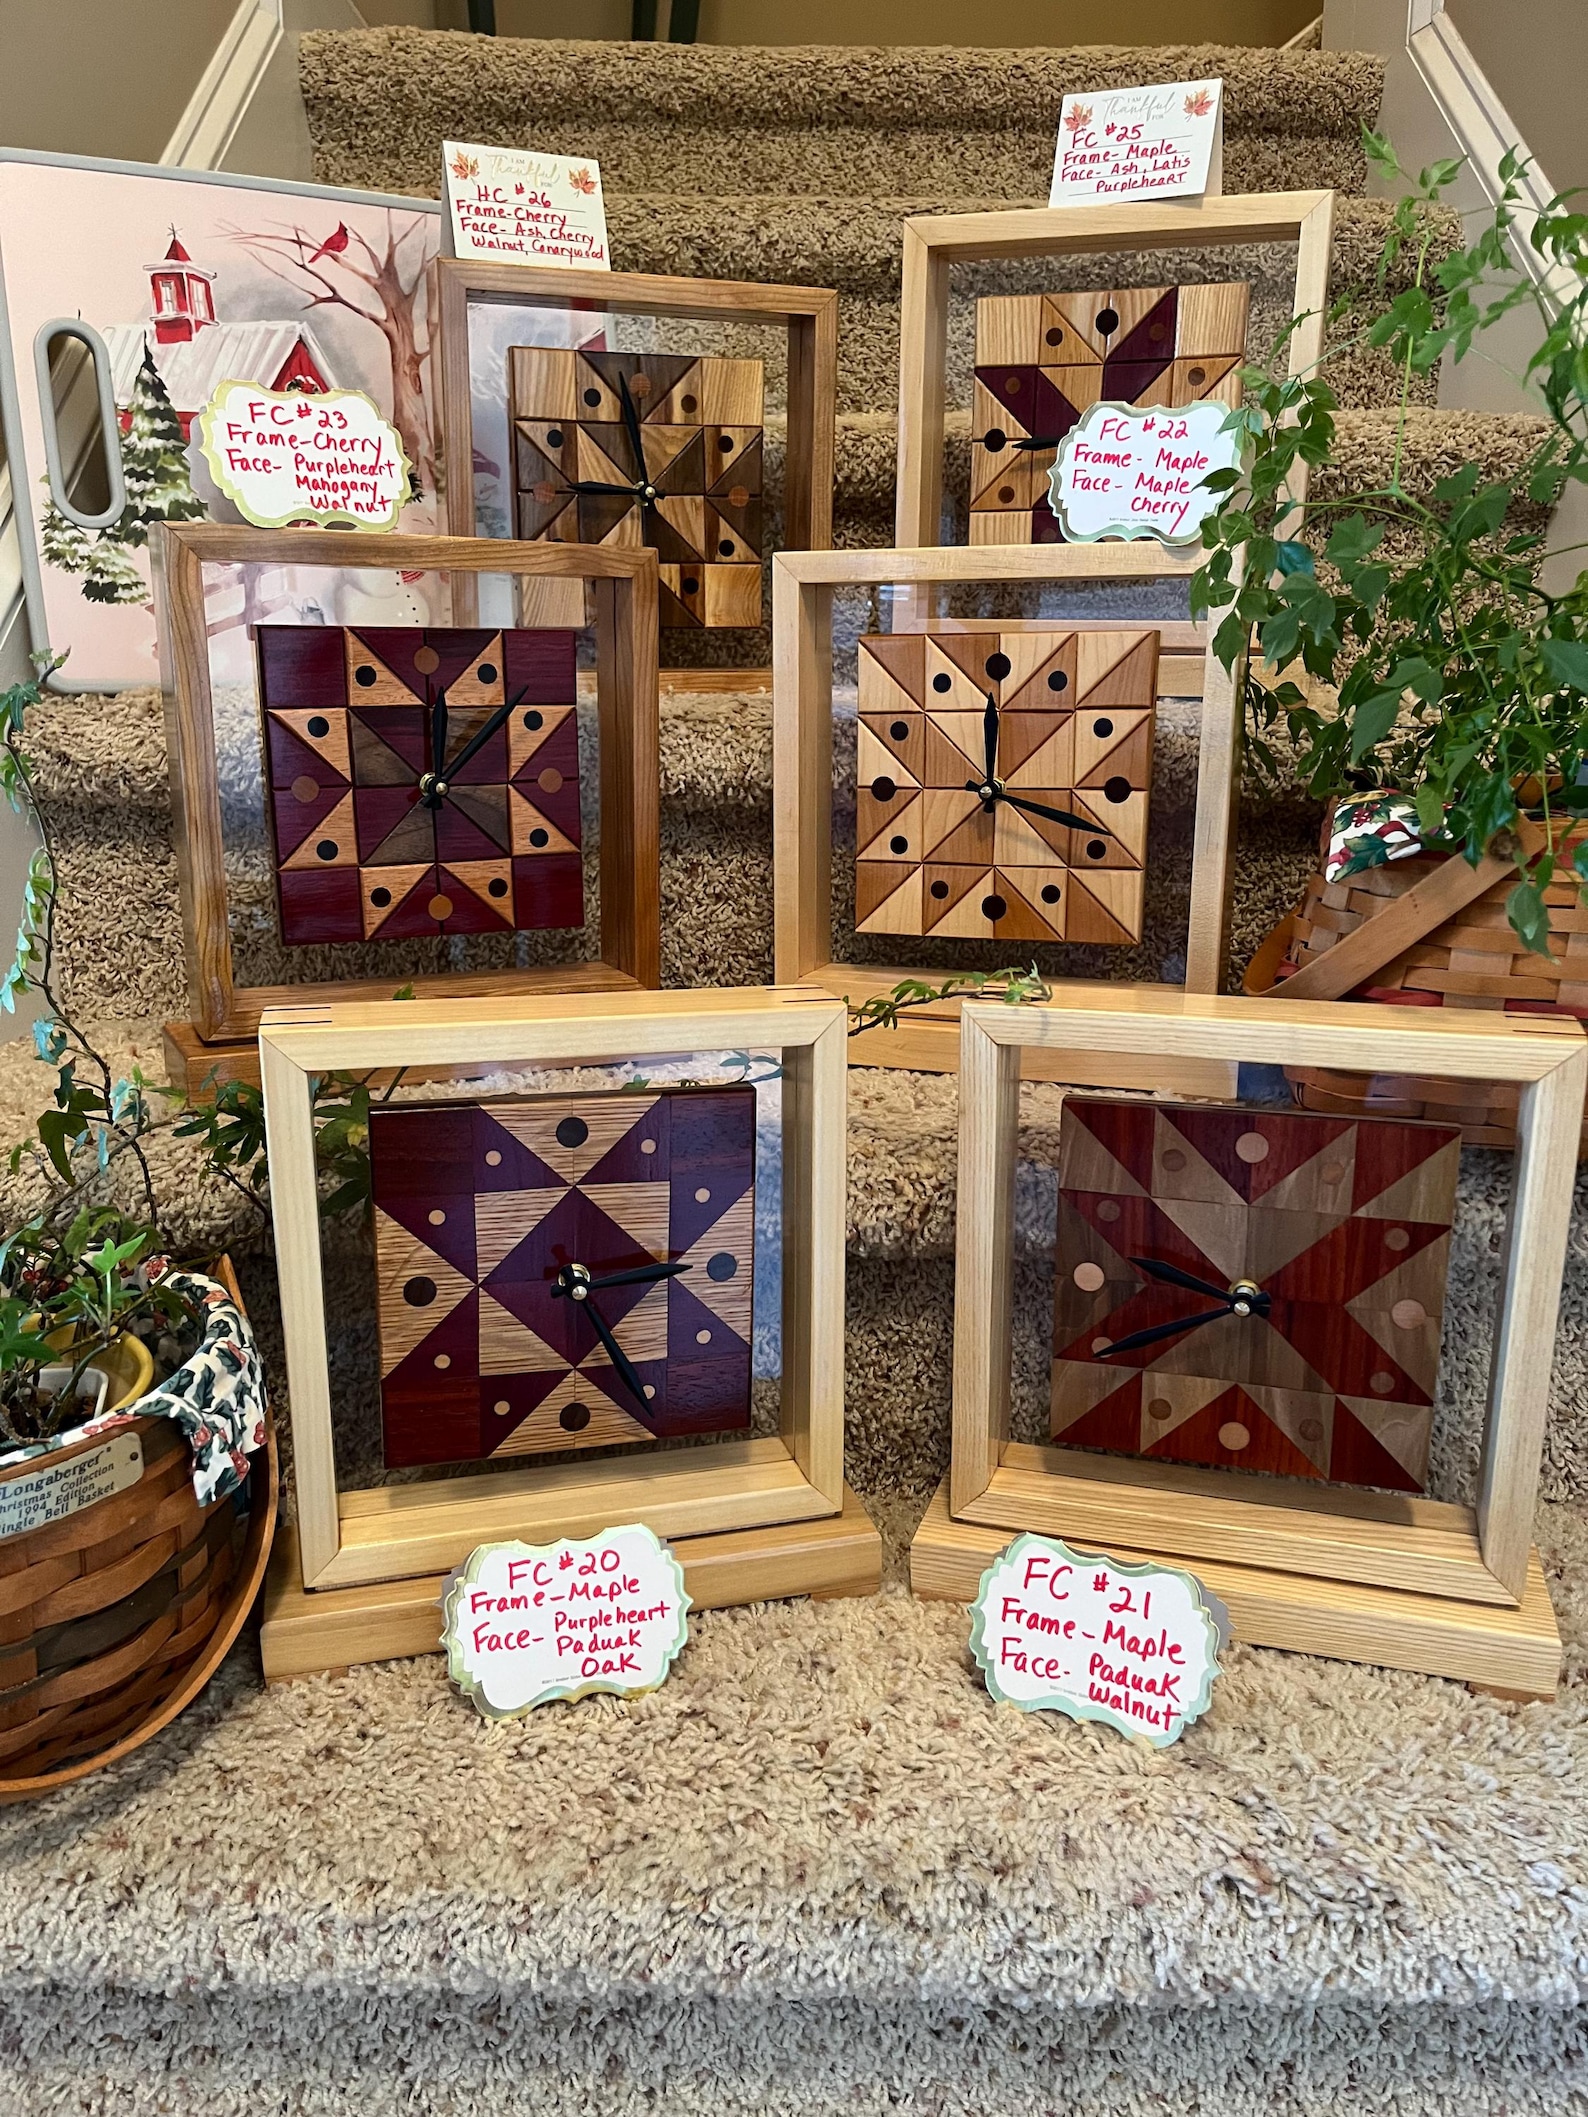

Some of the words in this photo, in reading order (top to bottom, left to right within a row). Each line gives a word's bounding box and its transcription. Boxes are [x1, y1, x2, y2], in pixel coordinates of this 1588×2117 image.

[1103, 92, 1175, 125] Thankful
[1072, 128, 1098, 148] FC
[1105, 123, 1144, 142] #25
[1127, 139, 1177, 159] Maple
[486, 154, 560, 188] Thankful
[1062, 165, 1101, 182] Face-
[477, 185, 508, 203] HC
[461, 217, 506, 232] Face-
[550, 228, 594, 250] Cherry
[249, 402, 294, 425] FC
[1100, 418, 1131, 441] FC
[226, 449, 282, 474] Face-
[294, 453, 395, 478] Purpleheart
[1156, 448, 1209, 473] Maple
[296, 474, 378, 503] Mahogany
[1135, 473, 1192, 496] Maple
[310, 496, 392, 513] Walnut
[0, 1491, 52, 1514] hristmas
[61, 1463, 114, 1492] Collection
[19, 1501, 47, 1518] 1994
[55, 1483, 95, 1505] Edition
[0, 1517, 35, 1533] ingle
[45, 1502, 69, 1520] Bell
[77, 1482, 114, 1506] Basket
[508, 1560, 553, 1589] FC
[559, 1550, 620, 1575] #20
[1024, 1557, 1073, 1600] FC
[473, 1622, 544, 1653] Face-
[555, 1601, 671, 1632] Purpleheart
[1001, 1637, 1070, 1679] Face-
[1088, 1682, 1181, 1731] Walnut
